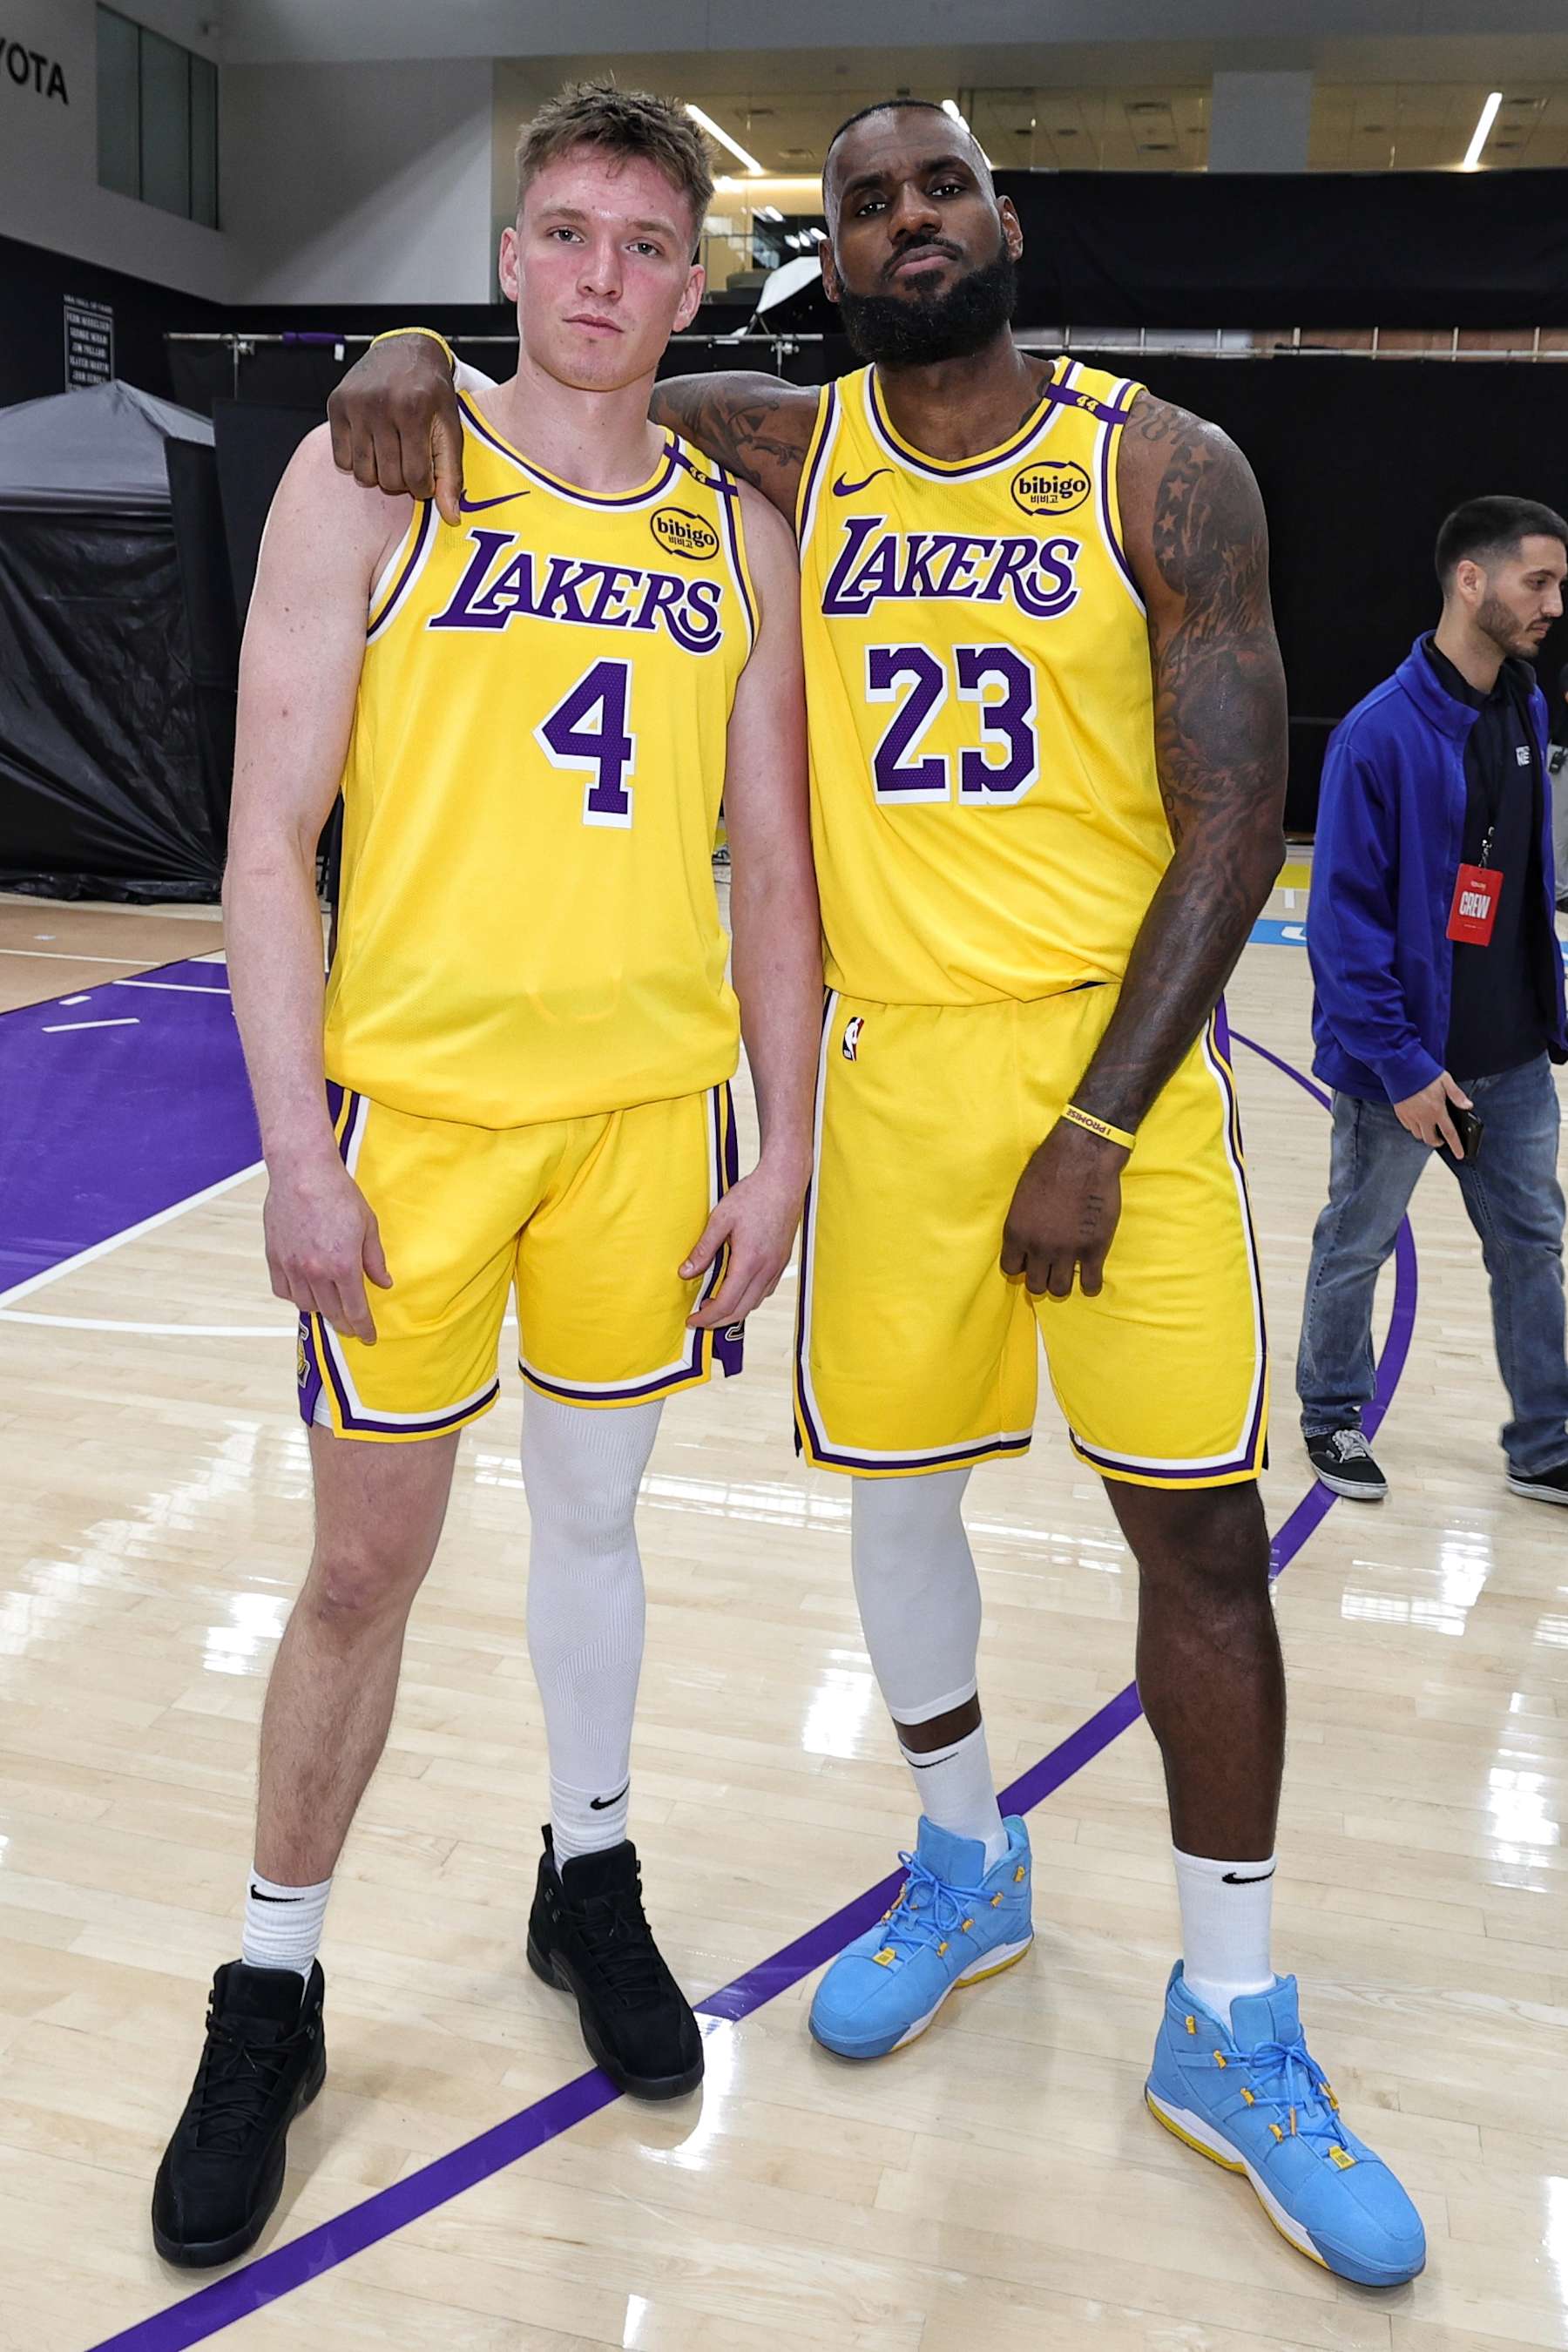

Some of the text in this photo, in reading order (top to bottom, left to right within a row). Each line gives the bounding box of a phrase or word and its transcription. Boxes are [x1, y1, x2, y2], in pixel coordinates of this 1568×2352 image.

[1077, 395, 1099, 412] 44
[1019, 475, 1086, 499] bibigo
[1031, 495, 1058, 504] 비비고
[657, 517, 715, 548] bibigo
[668, 535, 693, 549] 비비고
[821, 515, 1083, 619] LAKERS
[426, 527, 724, 655] LAKERS
[865, 643, 1040, 805] 23
[532, 657, 637, 828] 4
[1459, 890, 1491, 919] CREW
[1065, 1108, 1106, 1133] PROMISE
